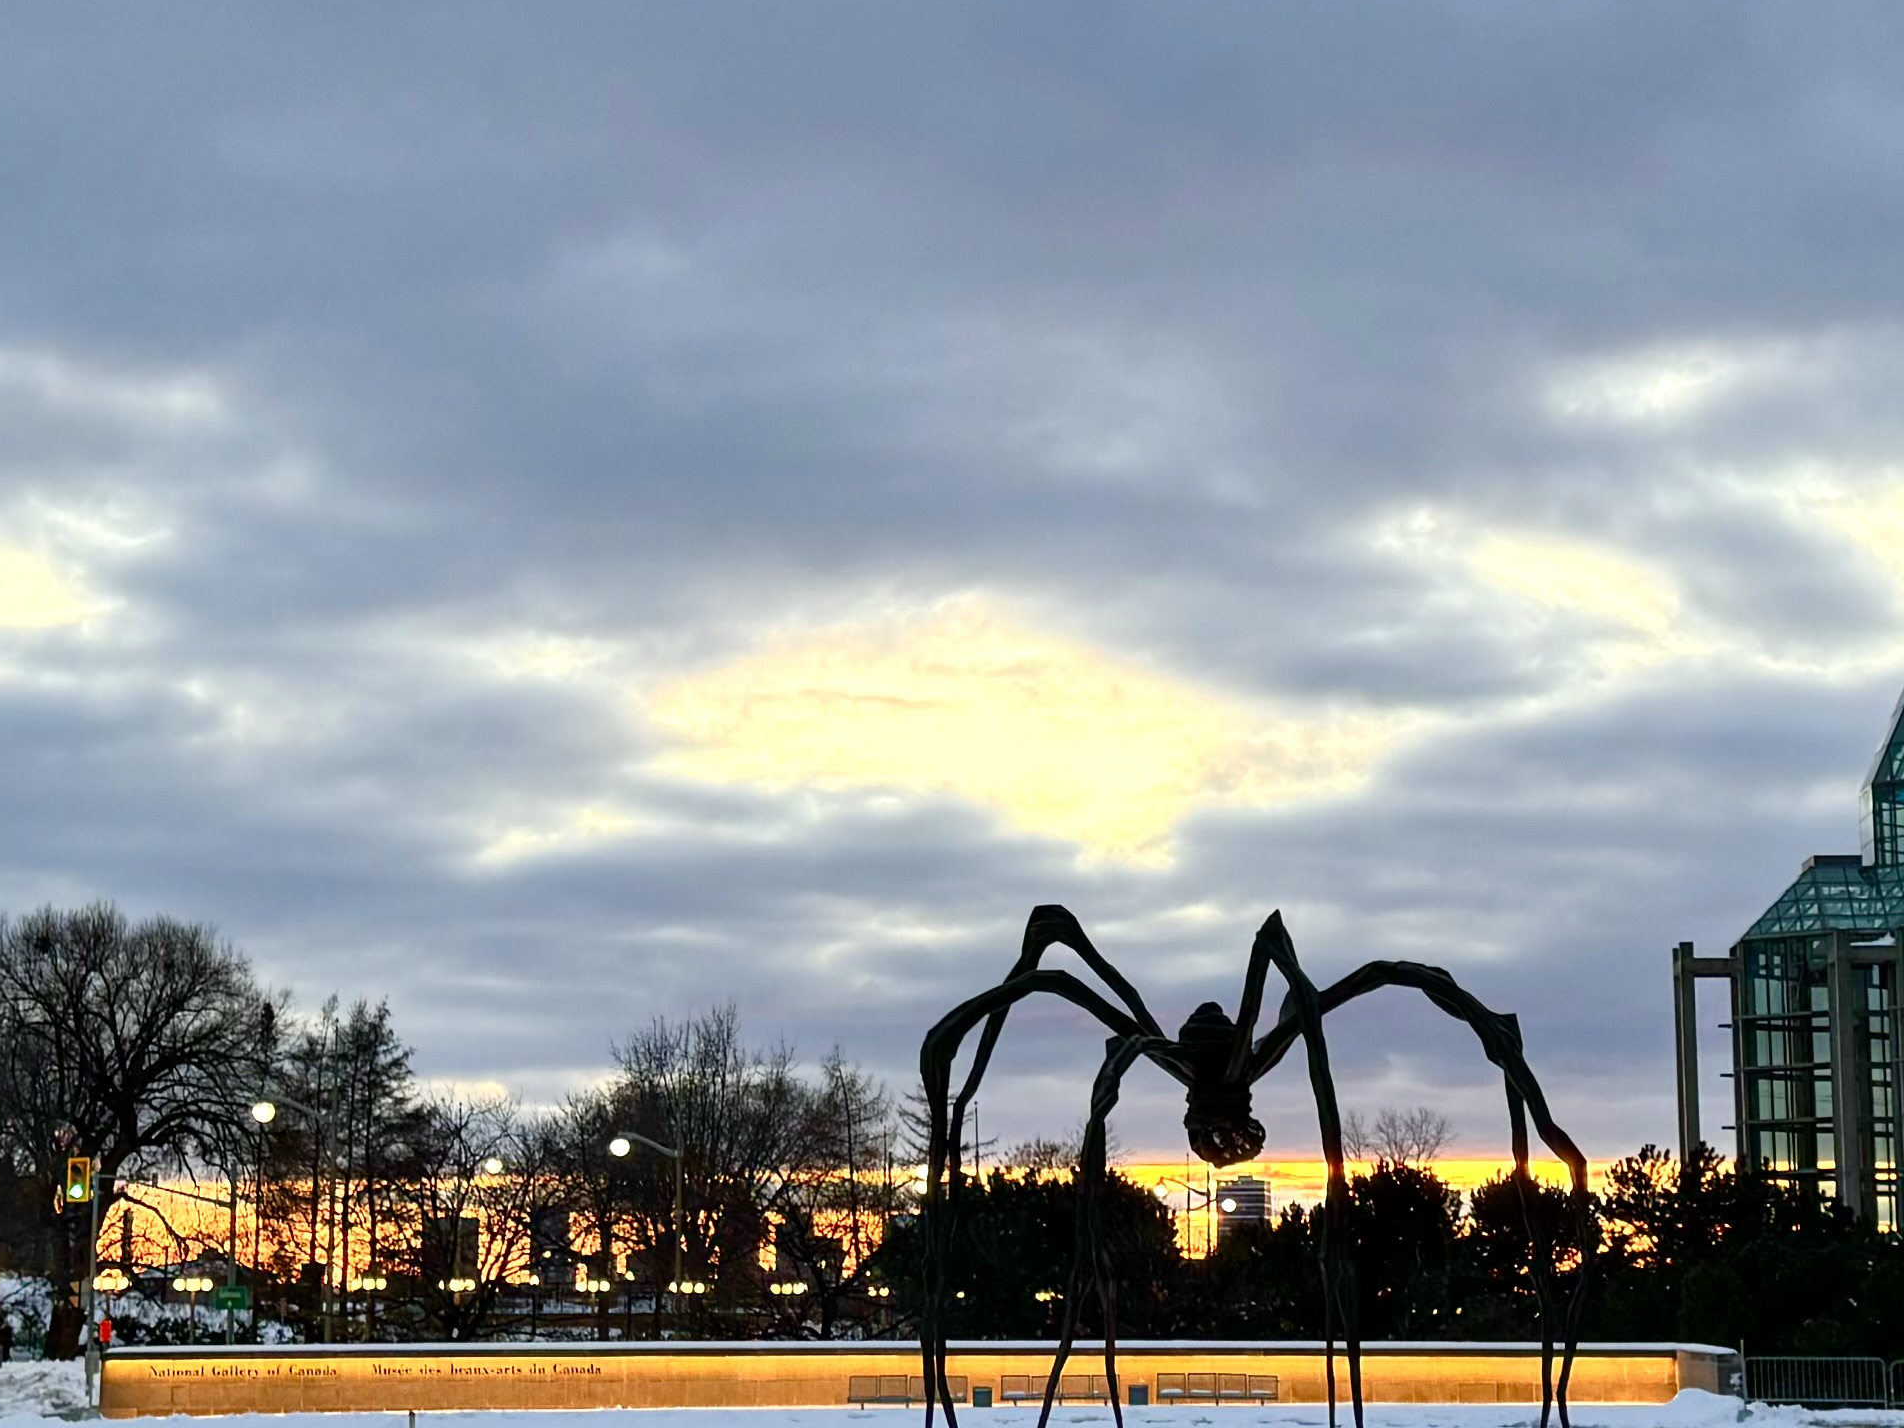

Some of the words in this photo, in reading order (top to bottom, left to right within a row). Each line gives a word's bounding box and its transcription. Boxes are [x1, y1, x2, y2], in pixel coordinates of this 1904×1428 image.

[149, 1365, 204, 1377] National
[212, 1365, 259, 1379] Gallery
[267, 1364, 282, 1377] of
[289, 1364, 337, 1376] Canada
[371, 1363, 413, 1375] Musée
[420, 1363, 442, 1375] des
[450, 1362, 522, 1375] beaux-arts
[529, 1363, 546, 1375] du
[553, 1363, 602, 1375] Canada
